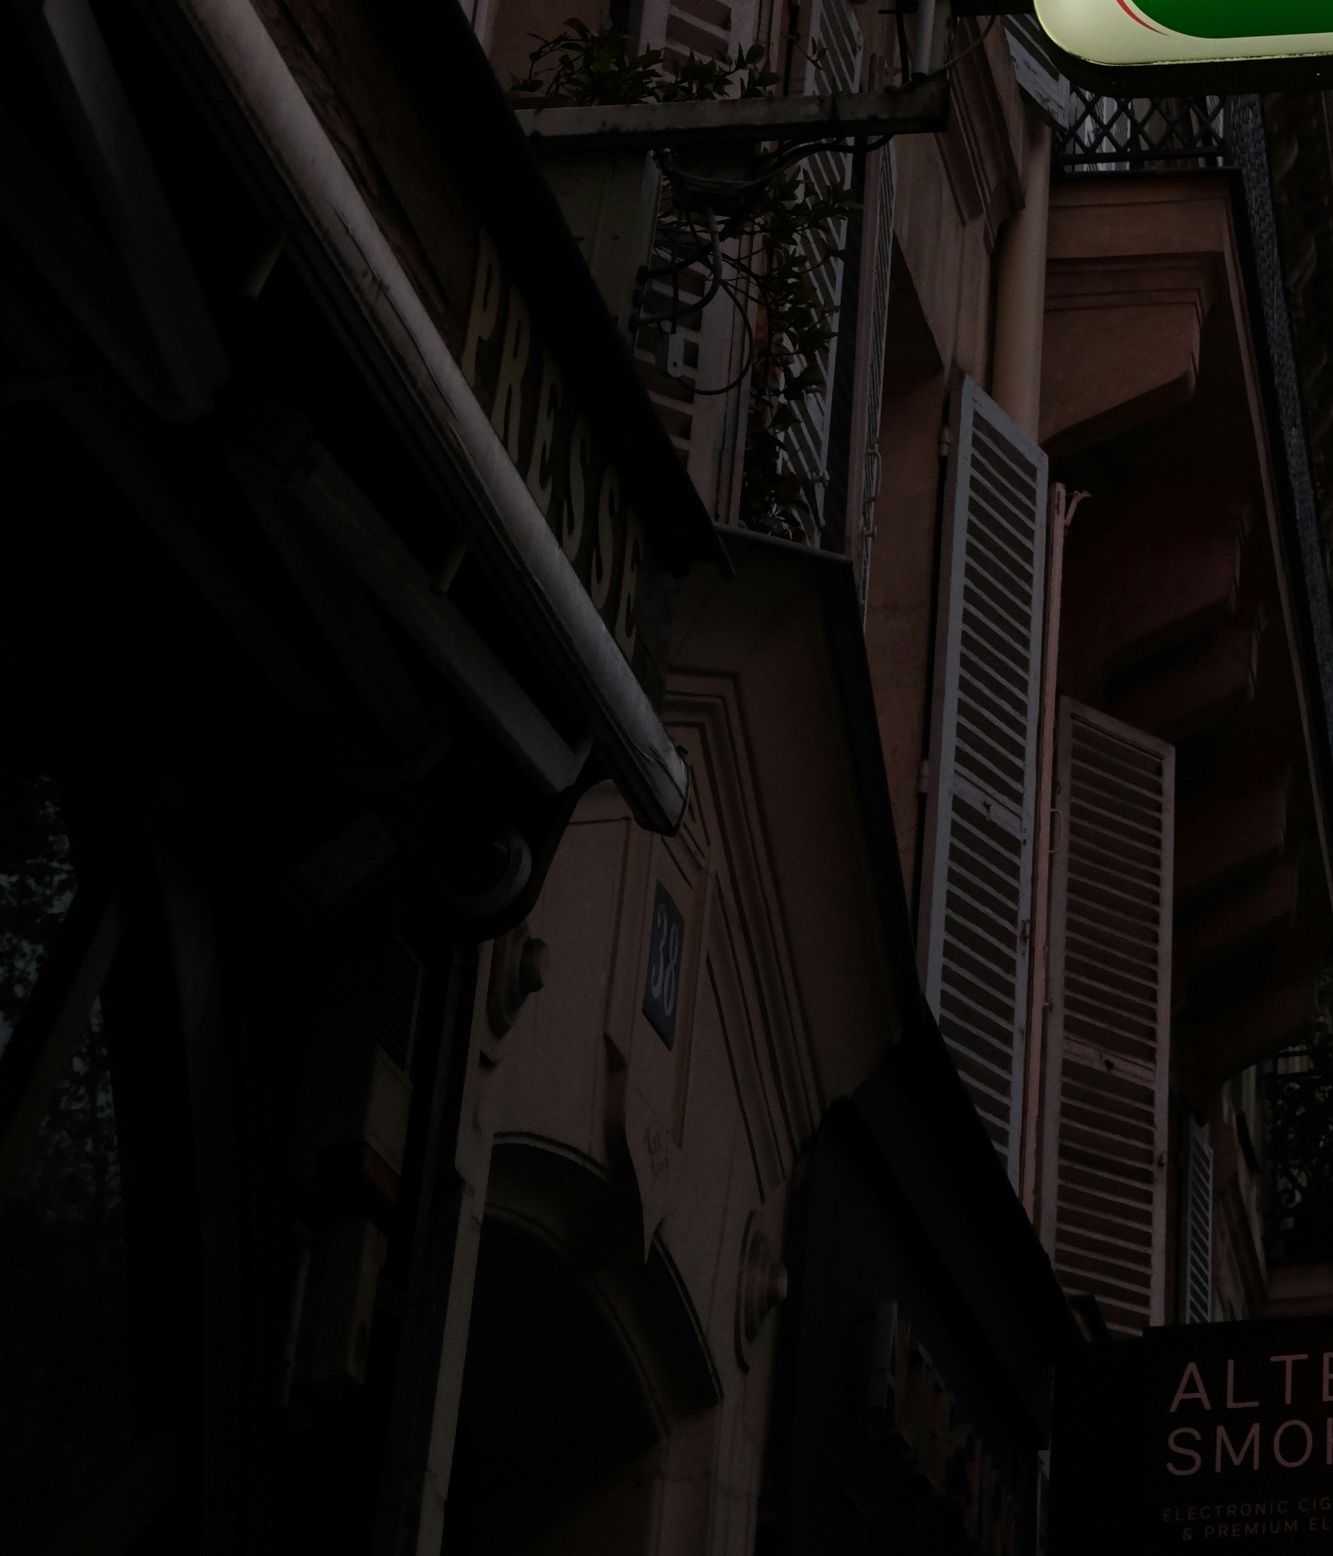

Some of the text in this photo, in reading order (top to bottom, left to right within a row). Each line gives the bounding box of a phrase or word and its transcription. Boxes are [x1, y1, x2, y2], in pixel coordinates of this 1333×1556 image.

[460, 224, 647, 661] PRESSE
[652, 903, 679, 1017] 38
[1162, 1499, 1289, 1523] ELECTRONIC
[1182, 1526, 1193, 1541] &
[1204, 1519, 1298, 1539] PREMIUM
